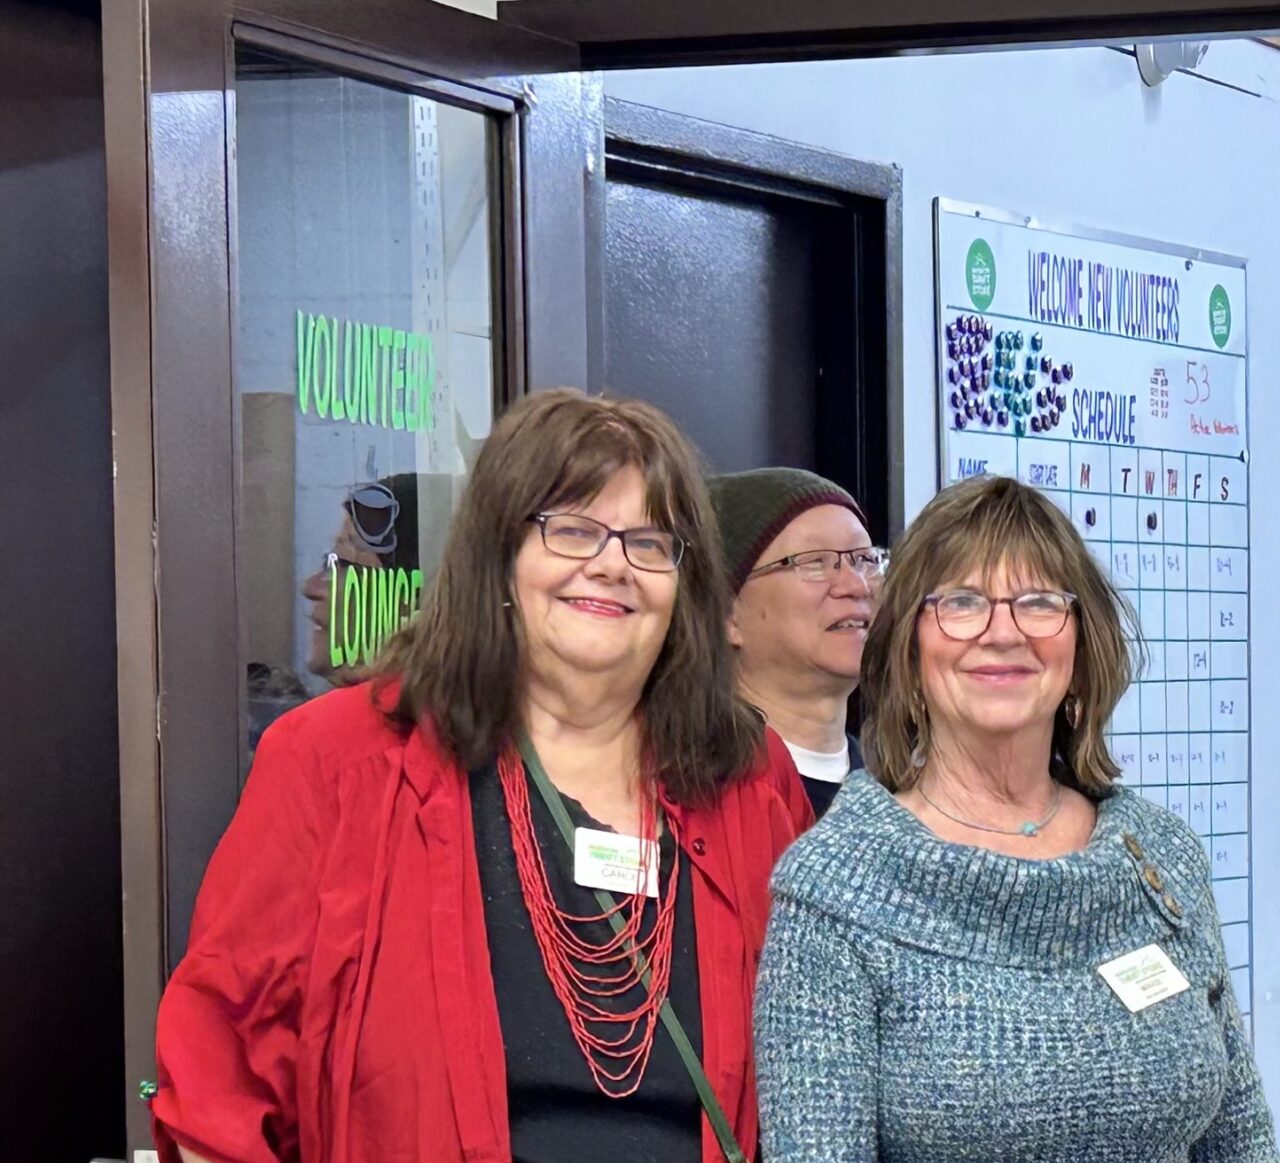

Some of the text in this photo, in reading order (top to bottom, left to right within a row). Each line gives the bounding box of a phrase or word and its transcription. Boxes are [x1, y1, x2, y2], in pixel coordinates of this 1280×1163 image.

[1028, 248, 1180, 343] WELCOME NEW VOLUNTEERS
[296, 309, 437, 433] VOLUNTEER
[1184, 360, 1211, 404] 53
[1072, 388, 1137, 444] SCHEDULE
[958, 458, 988, 478] NAME
[1080, 462, 1091, 490] M
[1121, 468, 1132, 493] T
[1145, 470, 1155, 495] W
[1193, 473, 1202, 499] F
[1220, 476, 1229, 501] S
